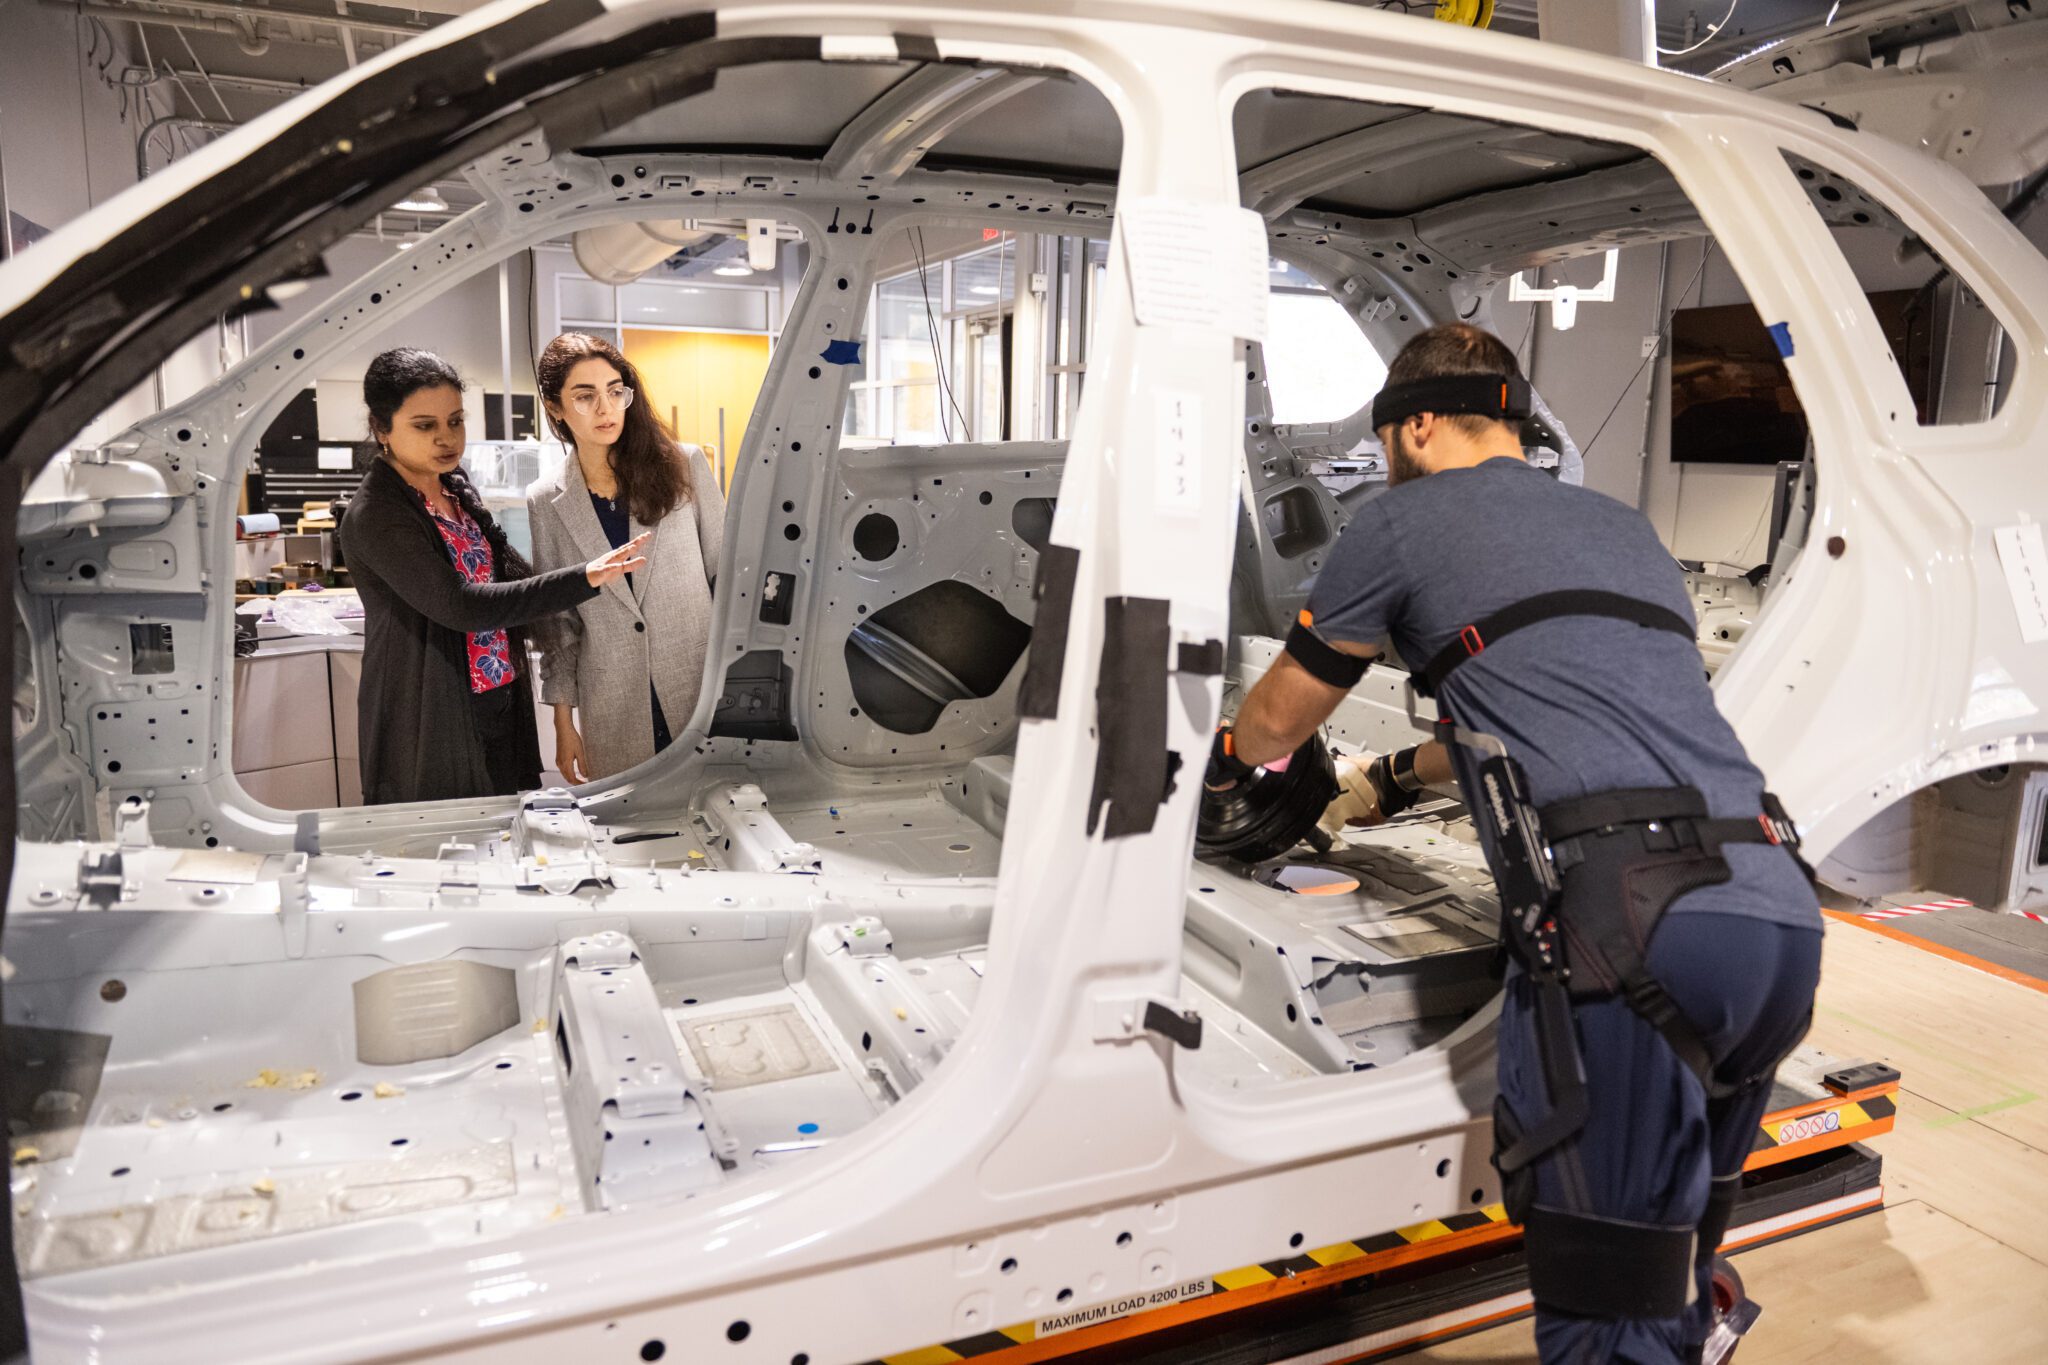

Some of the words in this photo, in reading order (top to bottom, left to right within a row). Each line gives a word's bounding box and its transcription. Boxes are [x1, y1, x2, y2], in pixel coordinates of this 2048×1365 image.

[1042, 1307, 1107, 1333] MAXIMUM
[1111, 1297, 1146, 1315] LOAD
[1149, 1288, 1178, 1305] 4200
[1181, 1281, 1206, 1297] LBS
